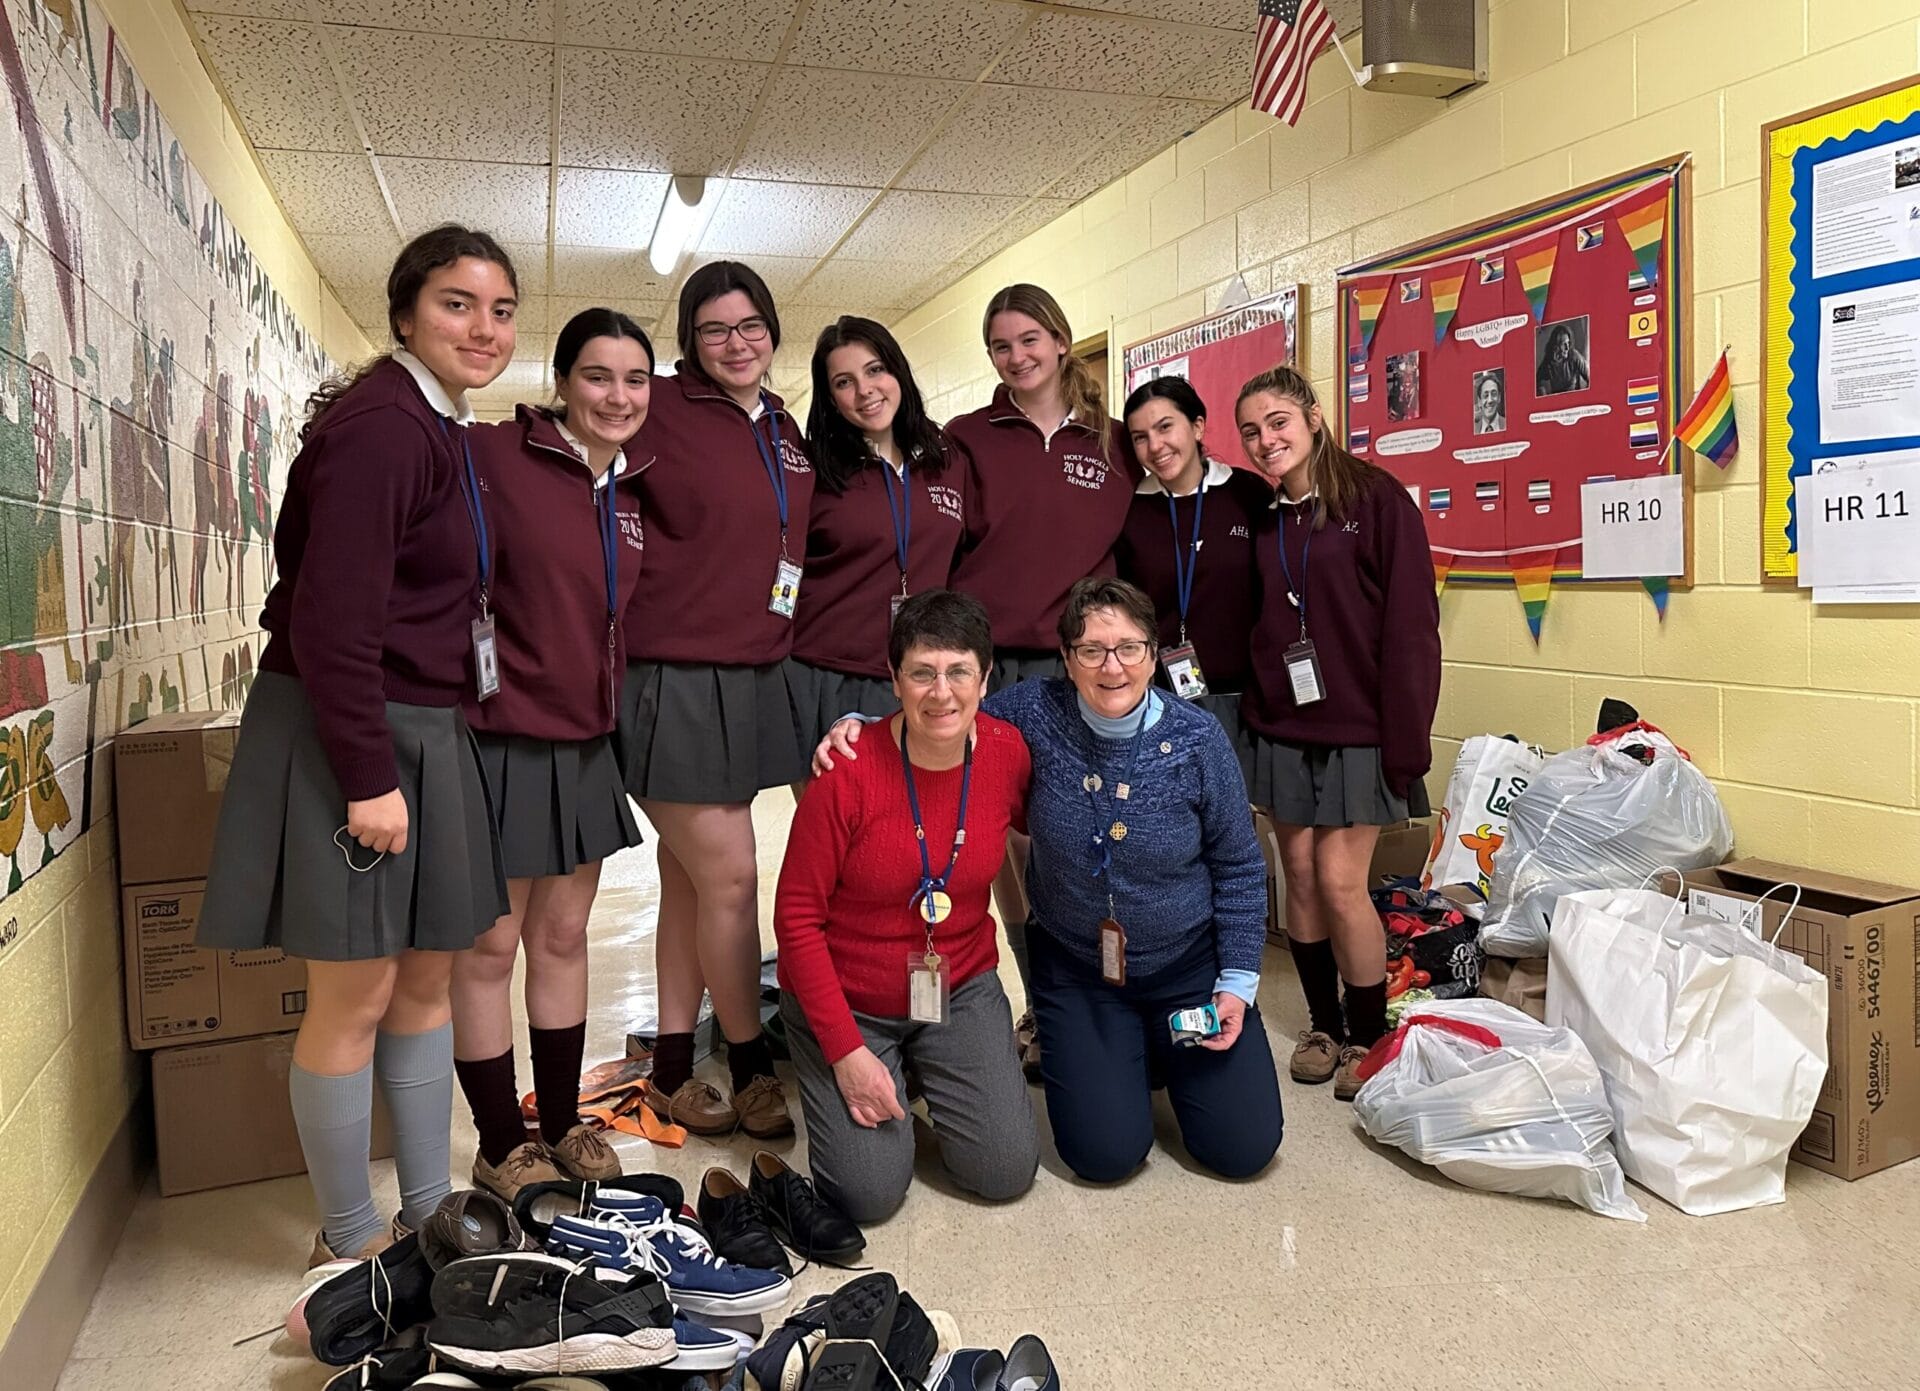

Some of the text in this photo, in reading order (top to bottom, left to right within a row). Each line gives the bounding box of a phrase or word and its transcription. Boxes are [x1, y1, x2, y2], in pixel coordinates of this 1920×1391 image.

[1475, 321, 1502, 333] LGBTQ+
[1063, 461, 1106, 483] 20 23
[1084, 456, 1109, 472] ANGELS
[1066, 475, 1100, 490] SENIORS
[930, 493, 942, 504] 20
[1824, 490, 1909, 523] HR 11
[1602, 498, 1661, 524] HR 10
[143, 904, 177, 917] TORK
[1858, 958, 1866, 994] 36000
[1866, 1030, 1884, 1114] Kleenex
